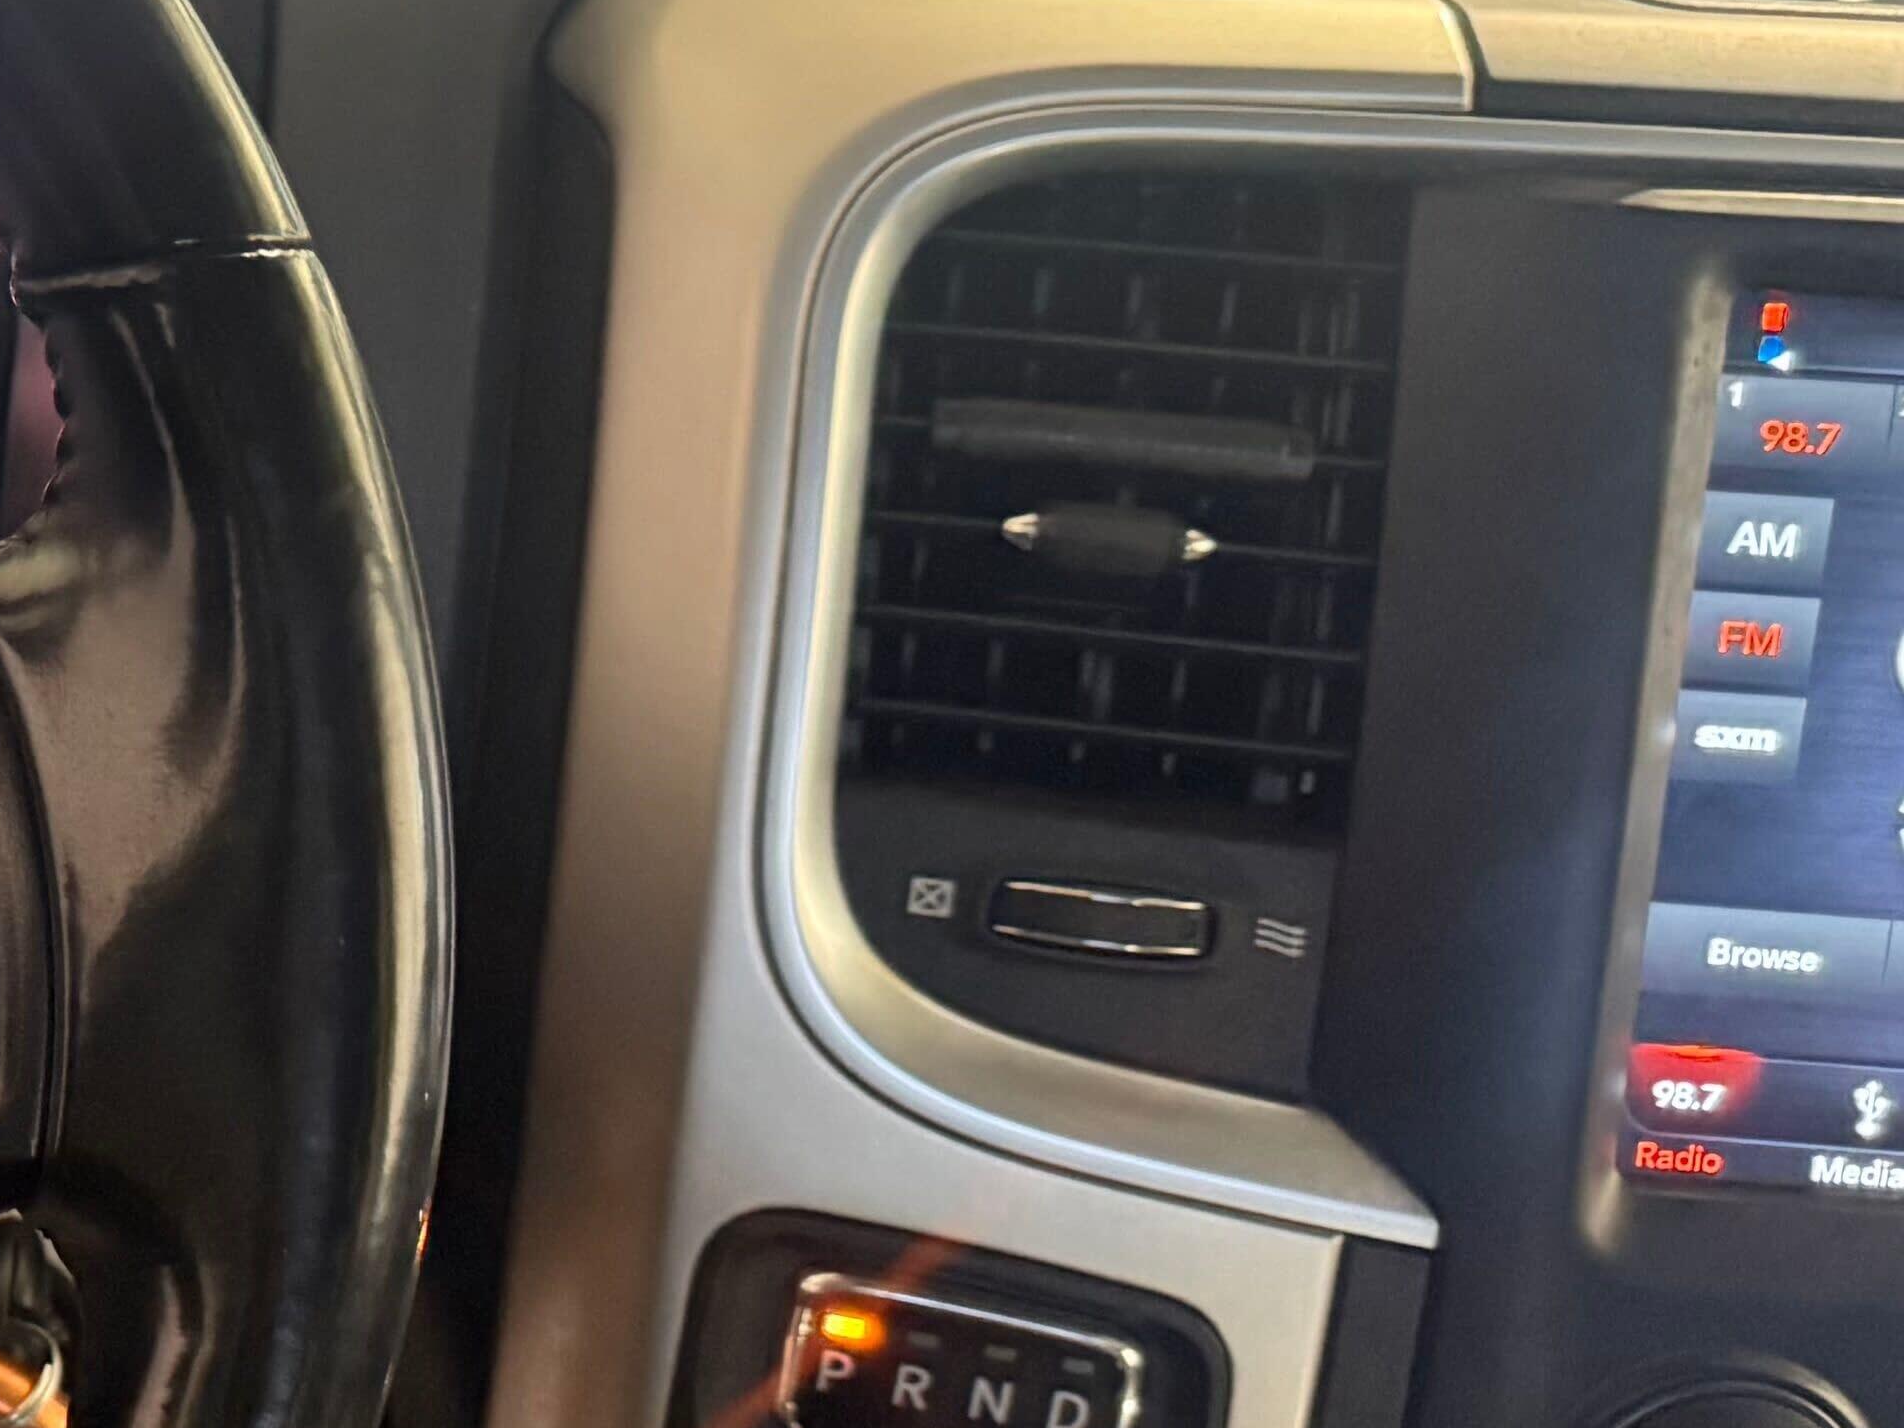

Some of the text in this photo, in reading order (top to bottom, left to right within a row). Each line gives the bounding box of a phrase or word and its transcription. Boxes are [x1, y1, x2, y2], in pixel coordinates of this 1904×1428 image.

[1727, 382, 1745, 409] 1
[1759, 419, 1843, 456] 98.7
[1727, 521, 1799, 559] AM
[1717, 619, 1784, 657] FM
[1707, 936, 1823, 974] Browse
[1651, 1078, 1727, 1113] 98.7
[1634, 1139, 1904, 1189] Radio Media
[815, 1349, 856, 1392] P
[891, 1362, 934, 1412] R
[966, 1375, 1013, 1425] N
